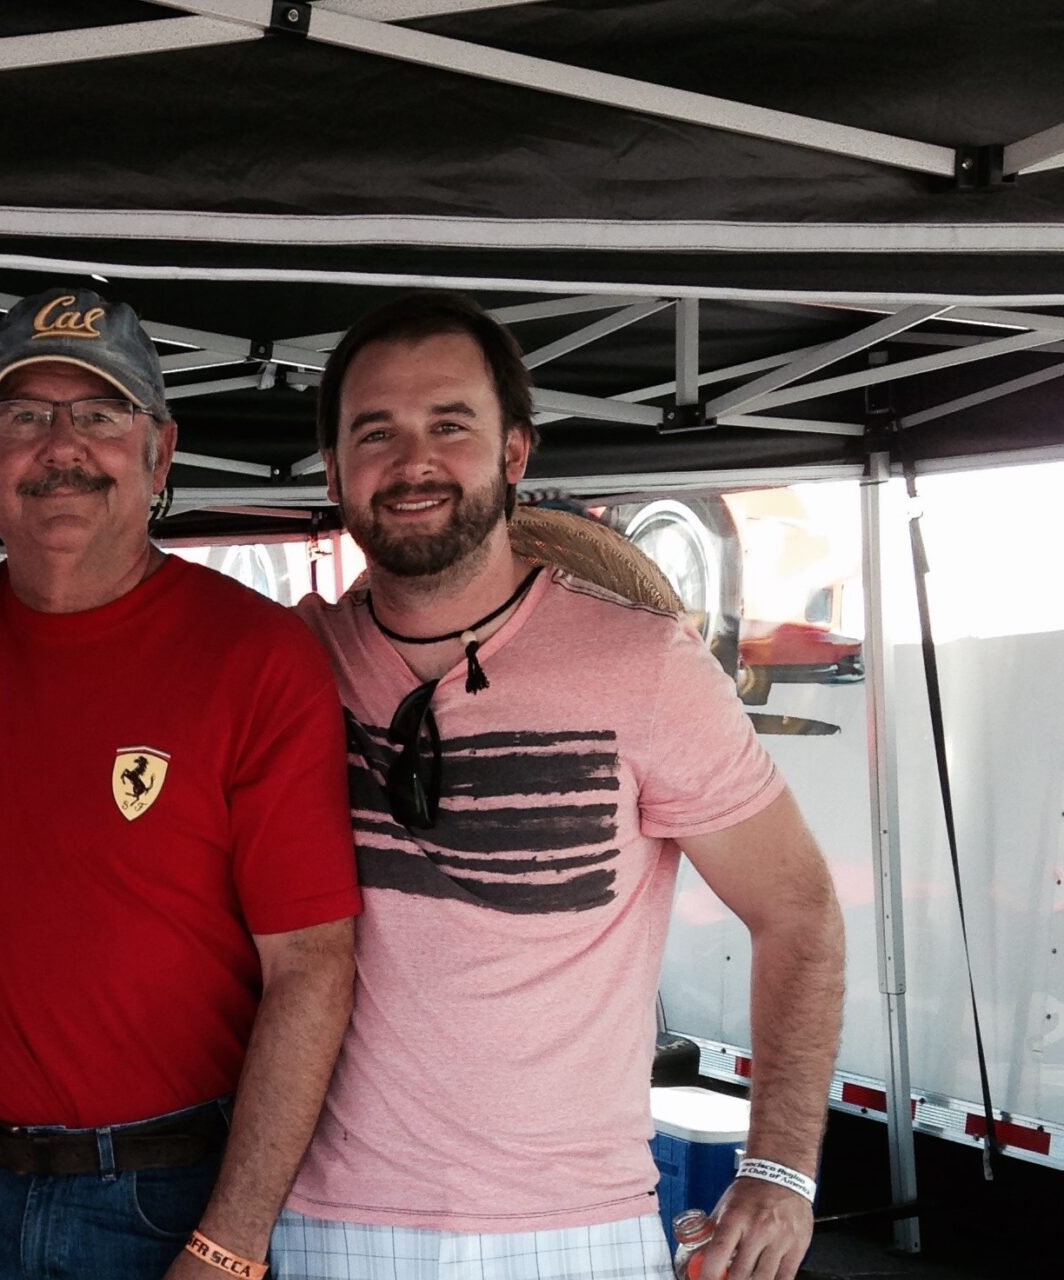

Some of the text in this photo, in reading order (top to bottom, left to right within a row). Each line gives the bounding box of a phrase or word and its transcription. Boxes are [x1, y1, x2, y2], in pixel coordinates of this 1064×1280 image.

[33, 295, 105, 339] Cal
[748, 1167, 768, 1176] Club
[777, 1167, 806, 1185] Region
[210, 1250, 251, 1278] SCCA
